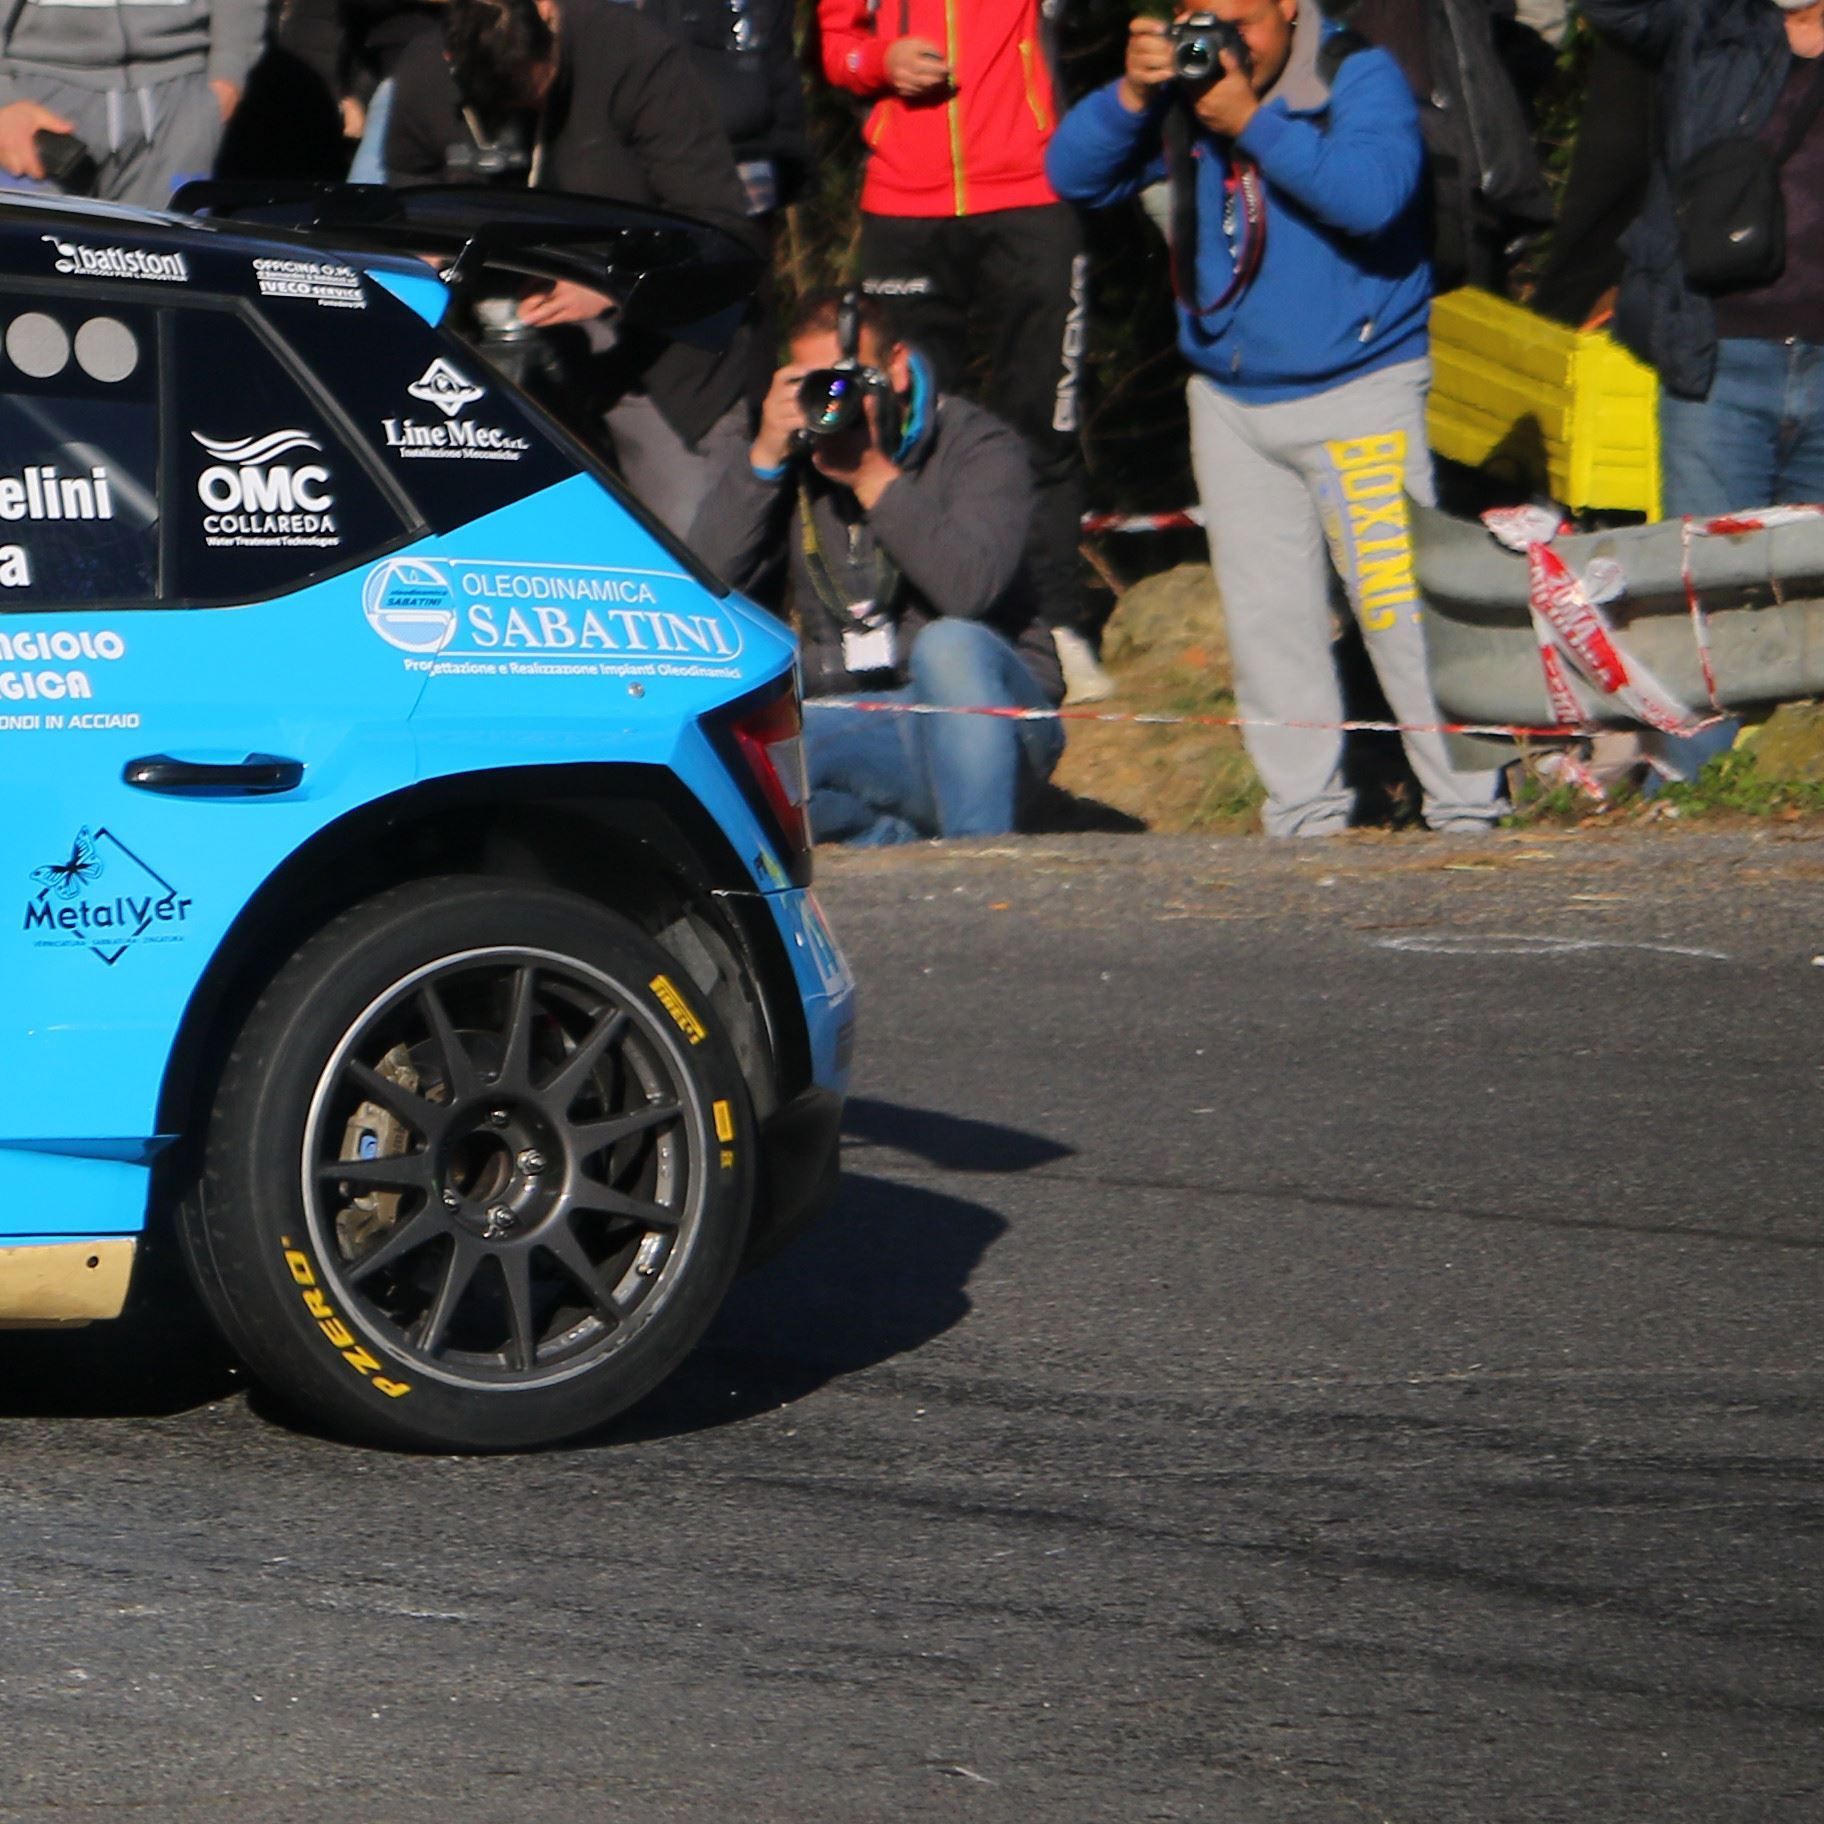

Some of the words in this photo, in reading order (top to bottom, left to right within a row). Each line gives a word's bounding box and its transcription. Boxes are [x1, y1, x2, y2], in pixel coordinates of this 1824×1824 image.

[252, 259, 320, 274] OFFICINA
[259, 280, 310, 294] IVECO
[312, 285, 363, 298] SERVICE
[198, 465, 333, 513] OMC
[203, 514, 336, 534] COLLAREDA
[206, 536, 235, 547] Water
[236, 536, 281, 547] Treatment
[462, 572, 657, 604] OLEODINAMICA
[386, 597, 443, 607] SABATINI
[467, 604, 734, 656] SABATINI
[499, 664, 508, 675] e
[510, 663, 599, 677] Realizzazione
[600, 663, 655, 678] Impianti
[657, 665, 742, 679] Oleodinamici
[46, 715, 62, 730] IN
[69, 713, 140, 730] ACCIAIO
[23, 895, 193, 931] MetalVer
